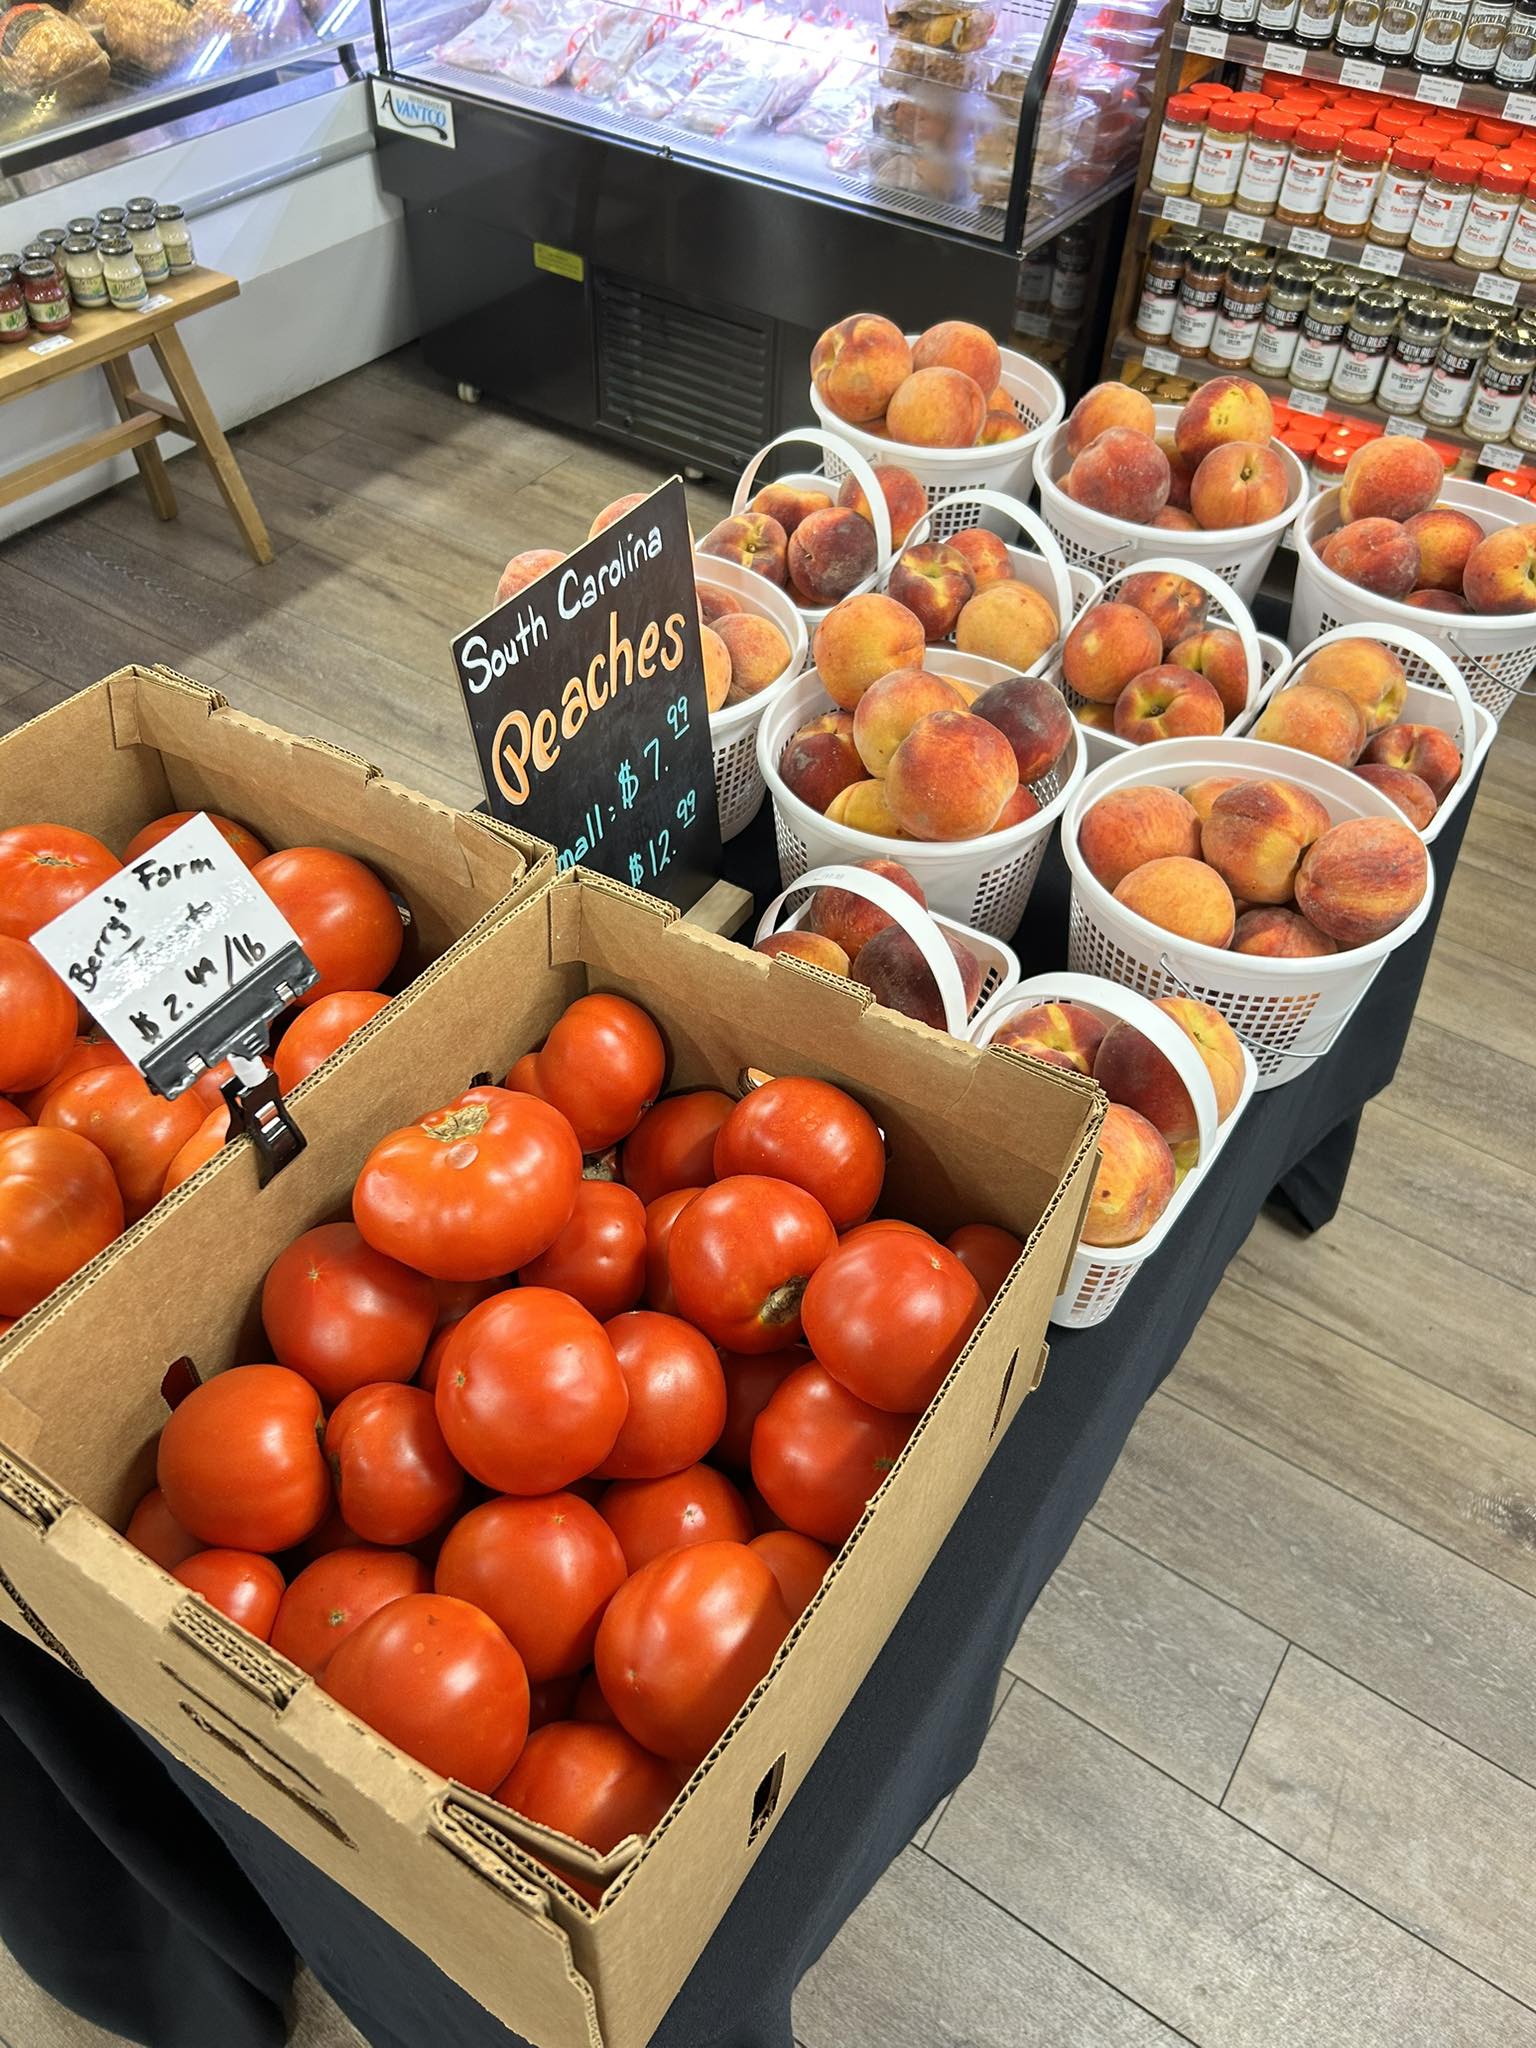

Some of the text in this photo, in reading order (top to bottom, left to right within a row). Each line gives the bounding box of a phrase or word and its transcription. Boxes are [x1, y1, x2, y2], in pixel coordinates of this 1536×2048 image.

[1470, 13, 1498, 25] COUNTRY
[381, 88, 447, 132] AVANTCO
[1154, 278, 1176, 290] RILES
[1195, 290, 1217, 303] RILES
[1244, 301, 1264, 314] RILES
[1275, 309, 1298, 322] RILES
[1320, 323, 1344, 337] RILES
[1367, 334, 1389, 348] RILES
[1397, 339, 1420, 355] HEATH
[1447, 355, 1470, 370] RILES
[1499, 372, 1524, 386] RILES
[1477, 399, 1500, 412] HONEY
[1478, 406, 1493, 418] RUB
[461, 525, 664, 695] South Carolina
[491, 611, 686, 807] Peaches
[556, 803, 617, 876] mall:
[69, 895, 128, 993] Berry's
[131, 857, 217, 892] Farm
